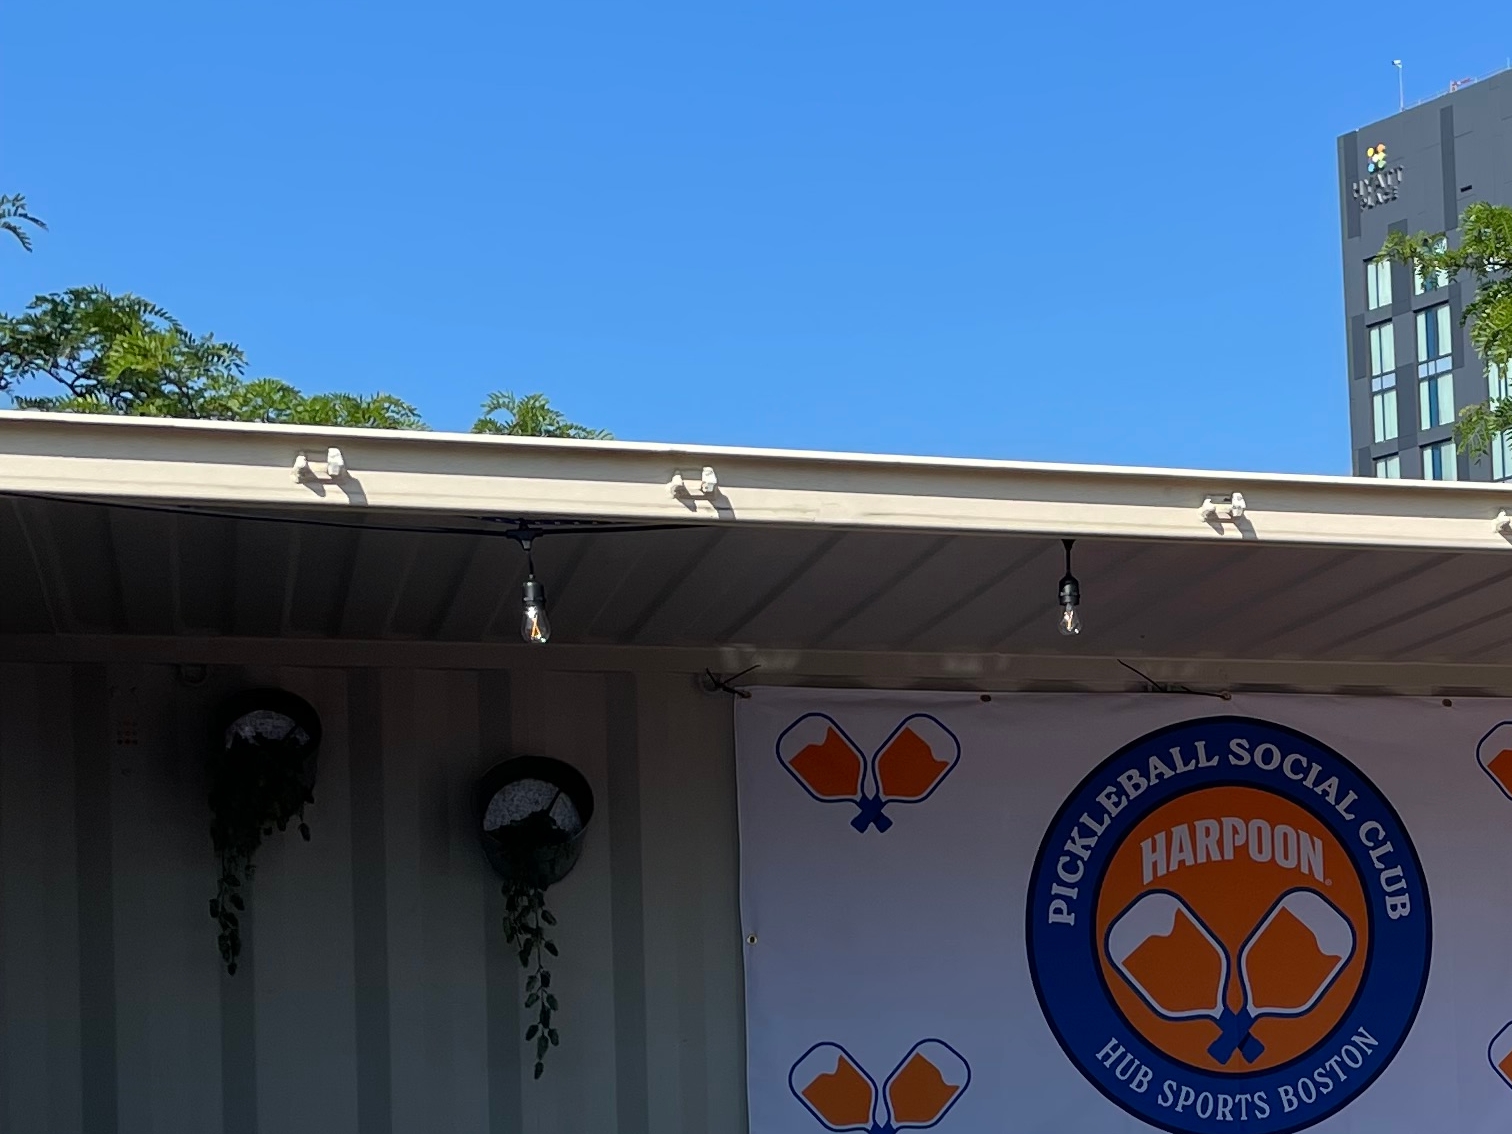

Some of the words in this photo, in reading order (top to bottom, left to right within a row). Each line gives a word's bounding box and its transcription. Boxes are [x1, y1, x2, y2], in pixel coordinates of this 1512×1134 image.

[1048, 740, 1219, 926] PICKLEBALL
[1227, 738, 1357, 821] SOCIAL
[1358, 820, 1412, 920] CLUB
[1096, 1037, 1153, 1094] HUB
[1157, 1080, 1271, 1122] SPORTS
[1282, 1026, 1379, 1113] BOSTON
